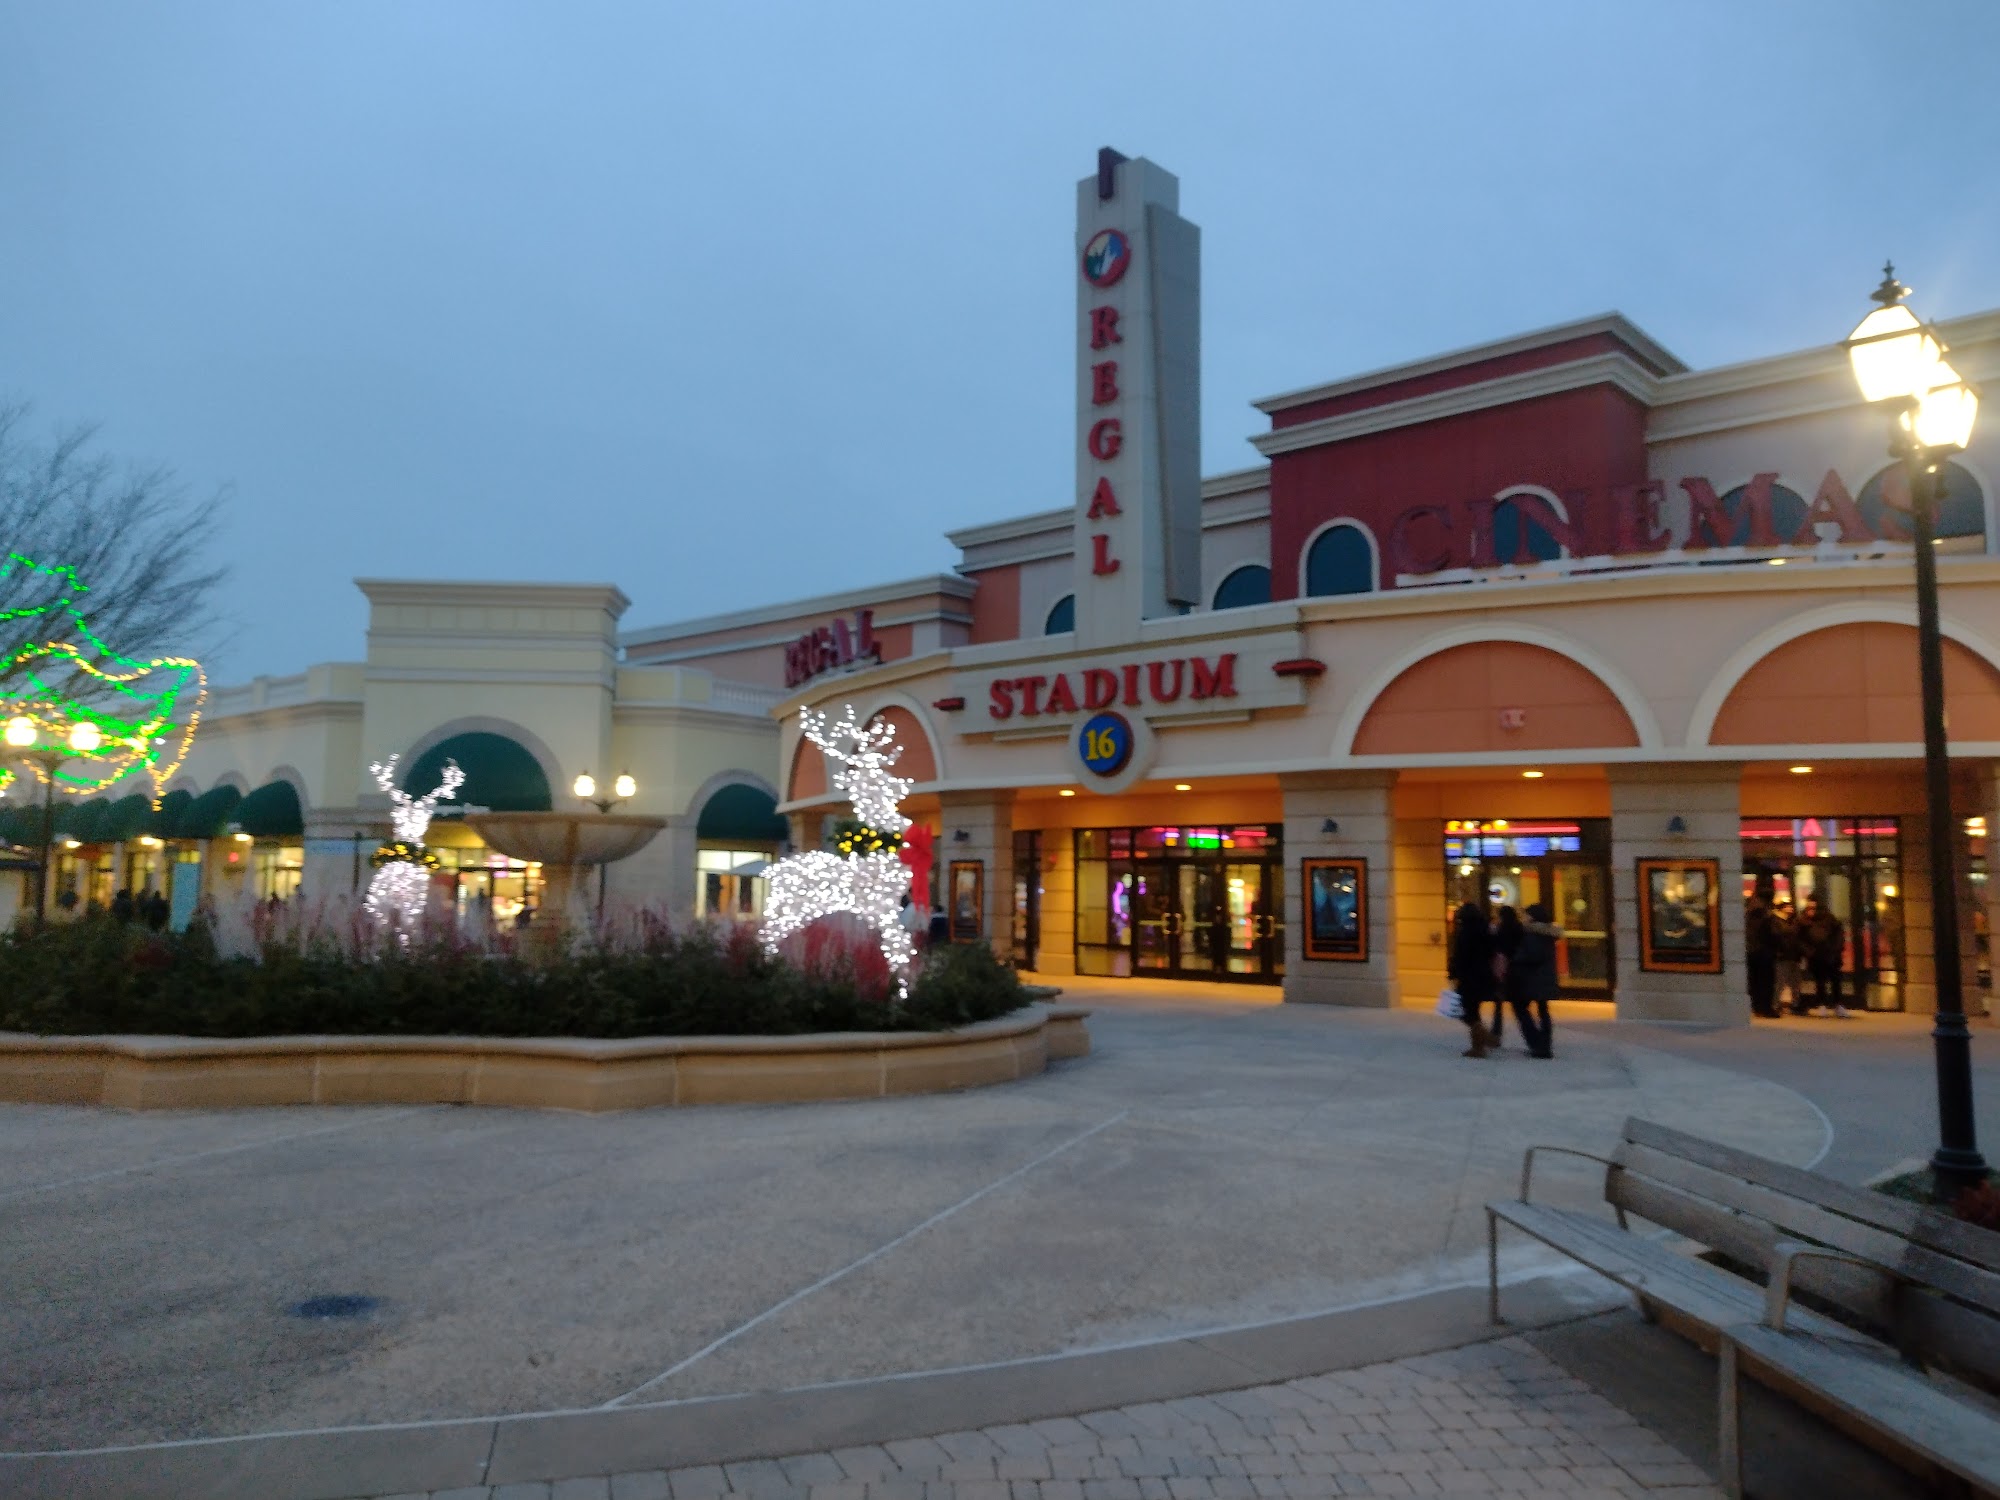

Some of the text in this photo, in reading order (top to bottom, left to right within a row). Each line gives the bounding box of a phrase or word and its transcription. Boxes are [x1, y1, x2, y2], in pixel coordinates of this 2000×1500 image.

[1087, 305, 1123, 576] REGAL
[989, 653, 1238, 719] STADIUM
[1086, 726, 1117, 760] 16
